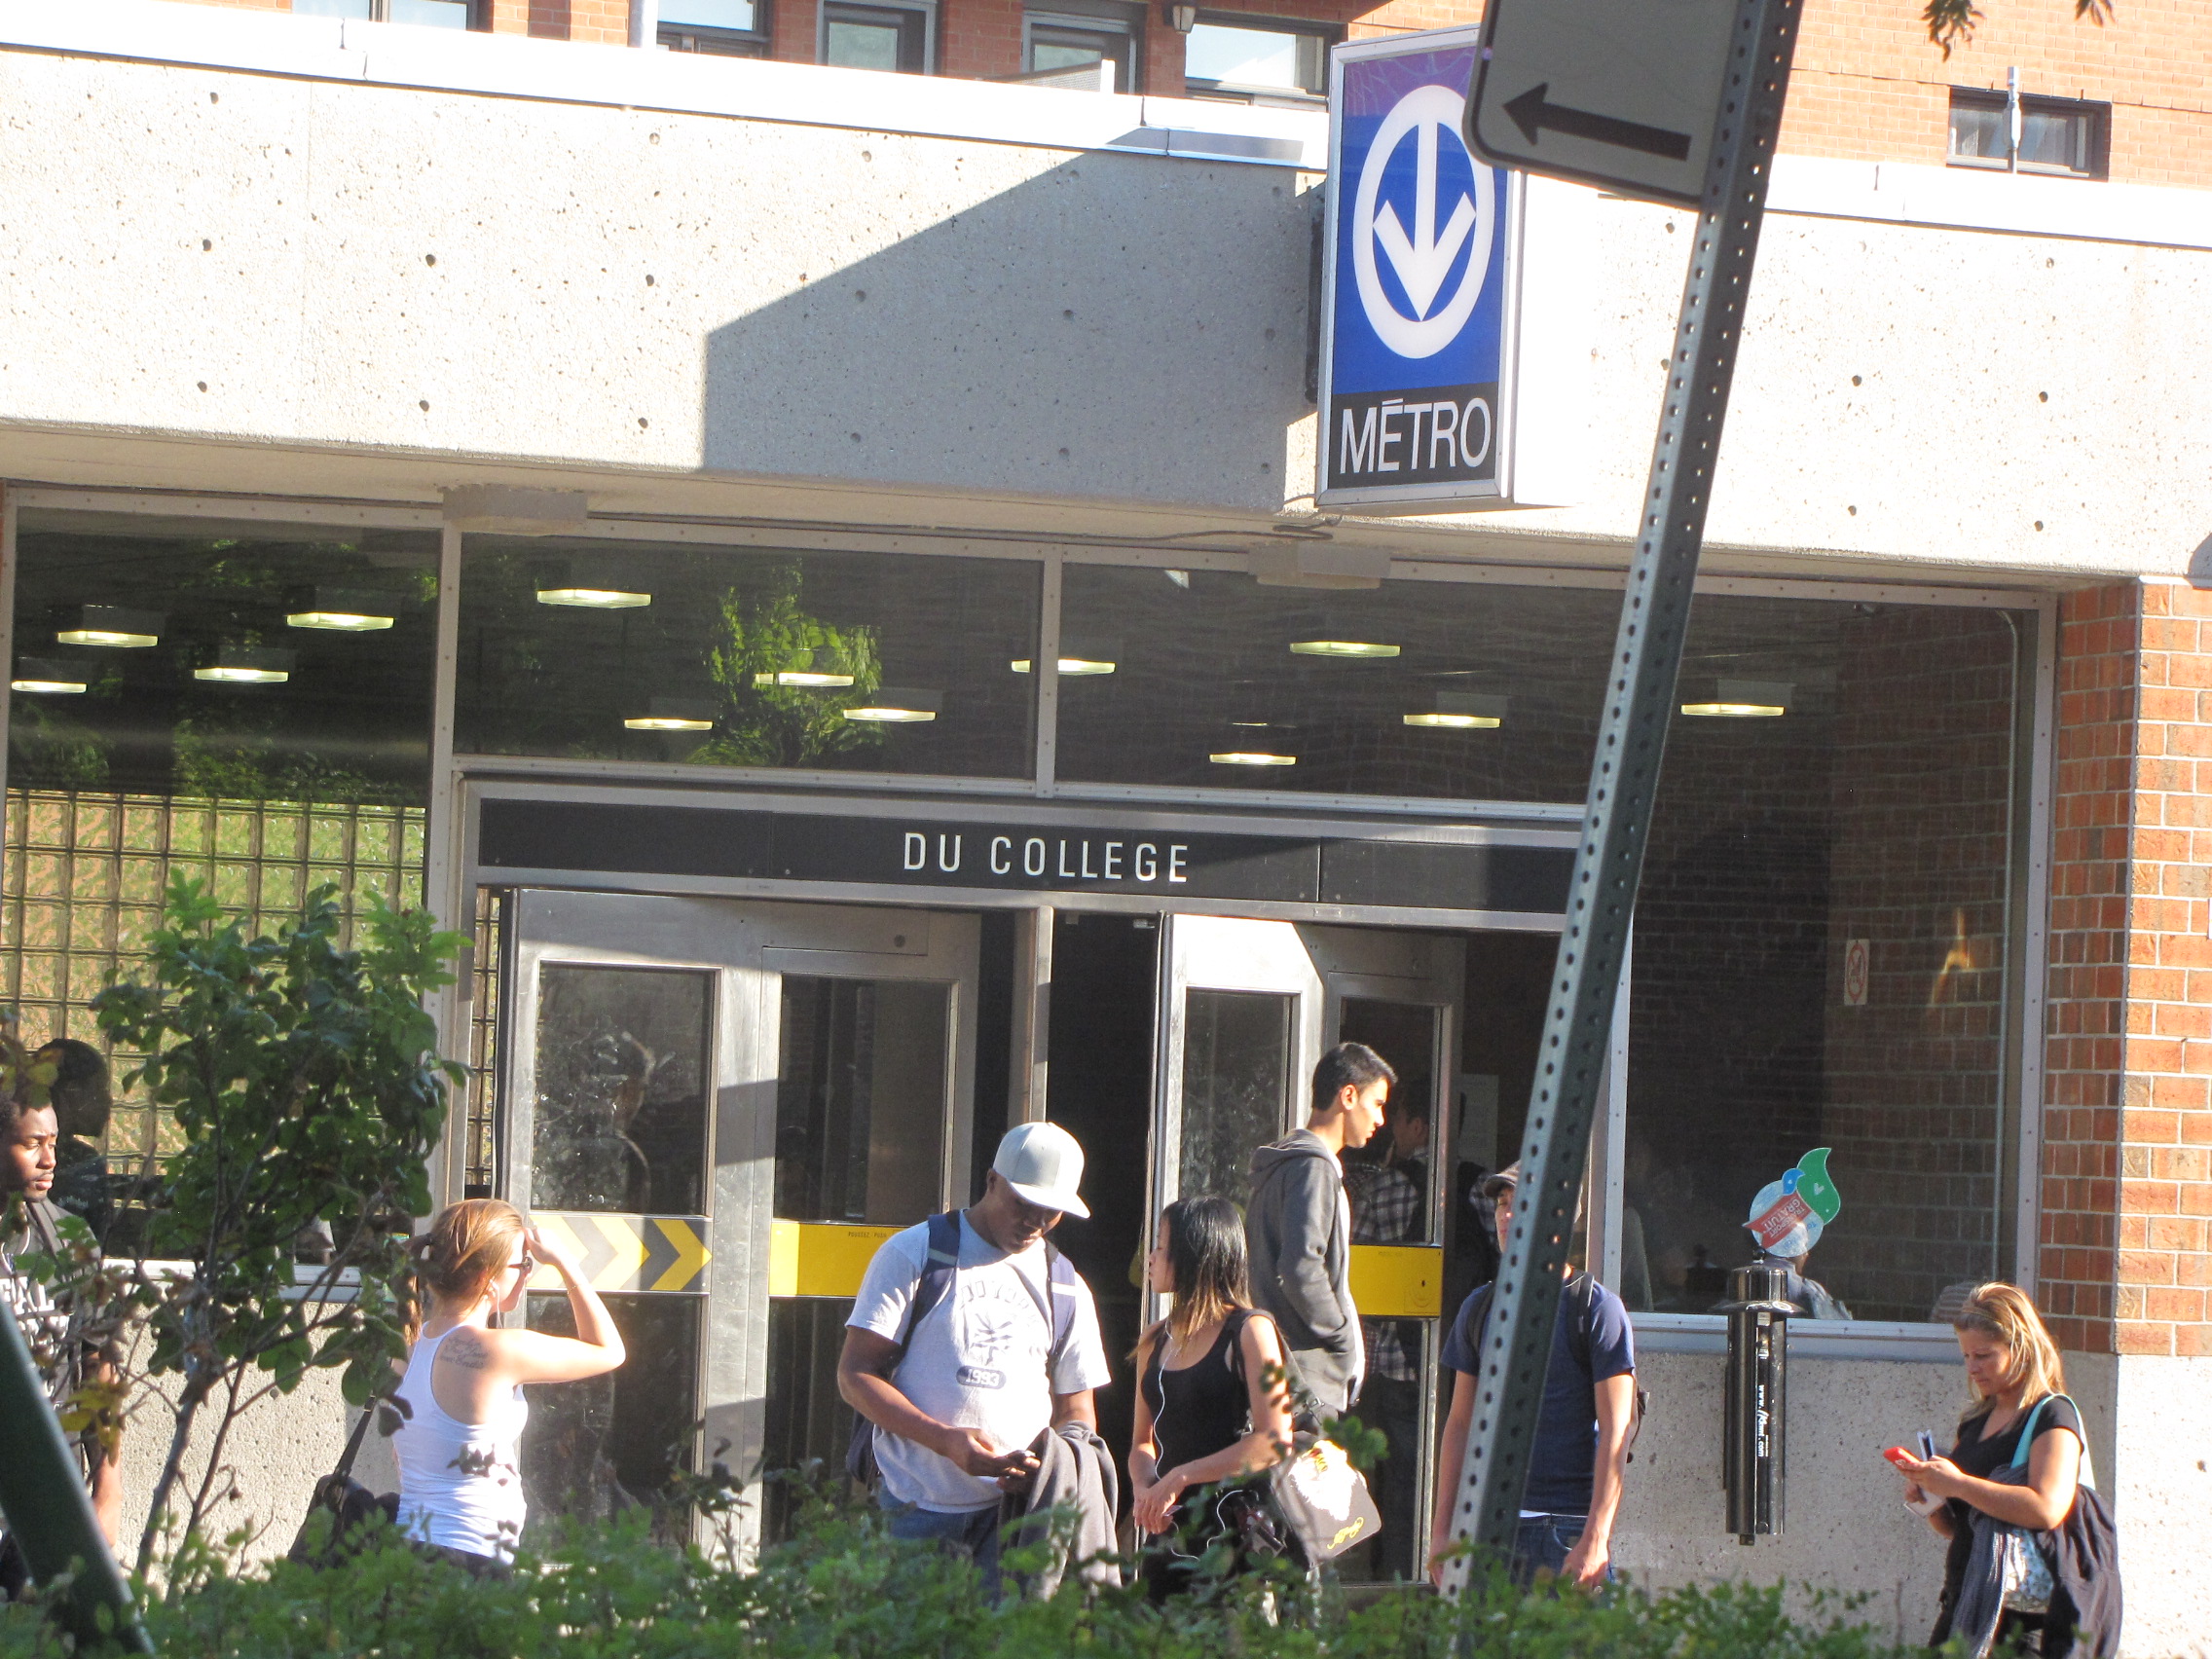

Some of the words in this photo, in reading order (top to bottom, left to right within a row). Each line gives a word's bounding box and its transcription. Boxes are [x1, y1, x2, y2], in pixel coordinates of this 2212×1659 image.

[1340, 397, 1492, 474] MÉTRO
[903, 832, 962, 872] DU
[990, 836, 1188, 883] COLLEGE
[1763, 1198, 1801, 1233] GRATUIT
[966, 1368, 1000, 1386] 1993
